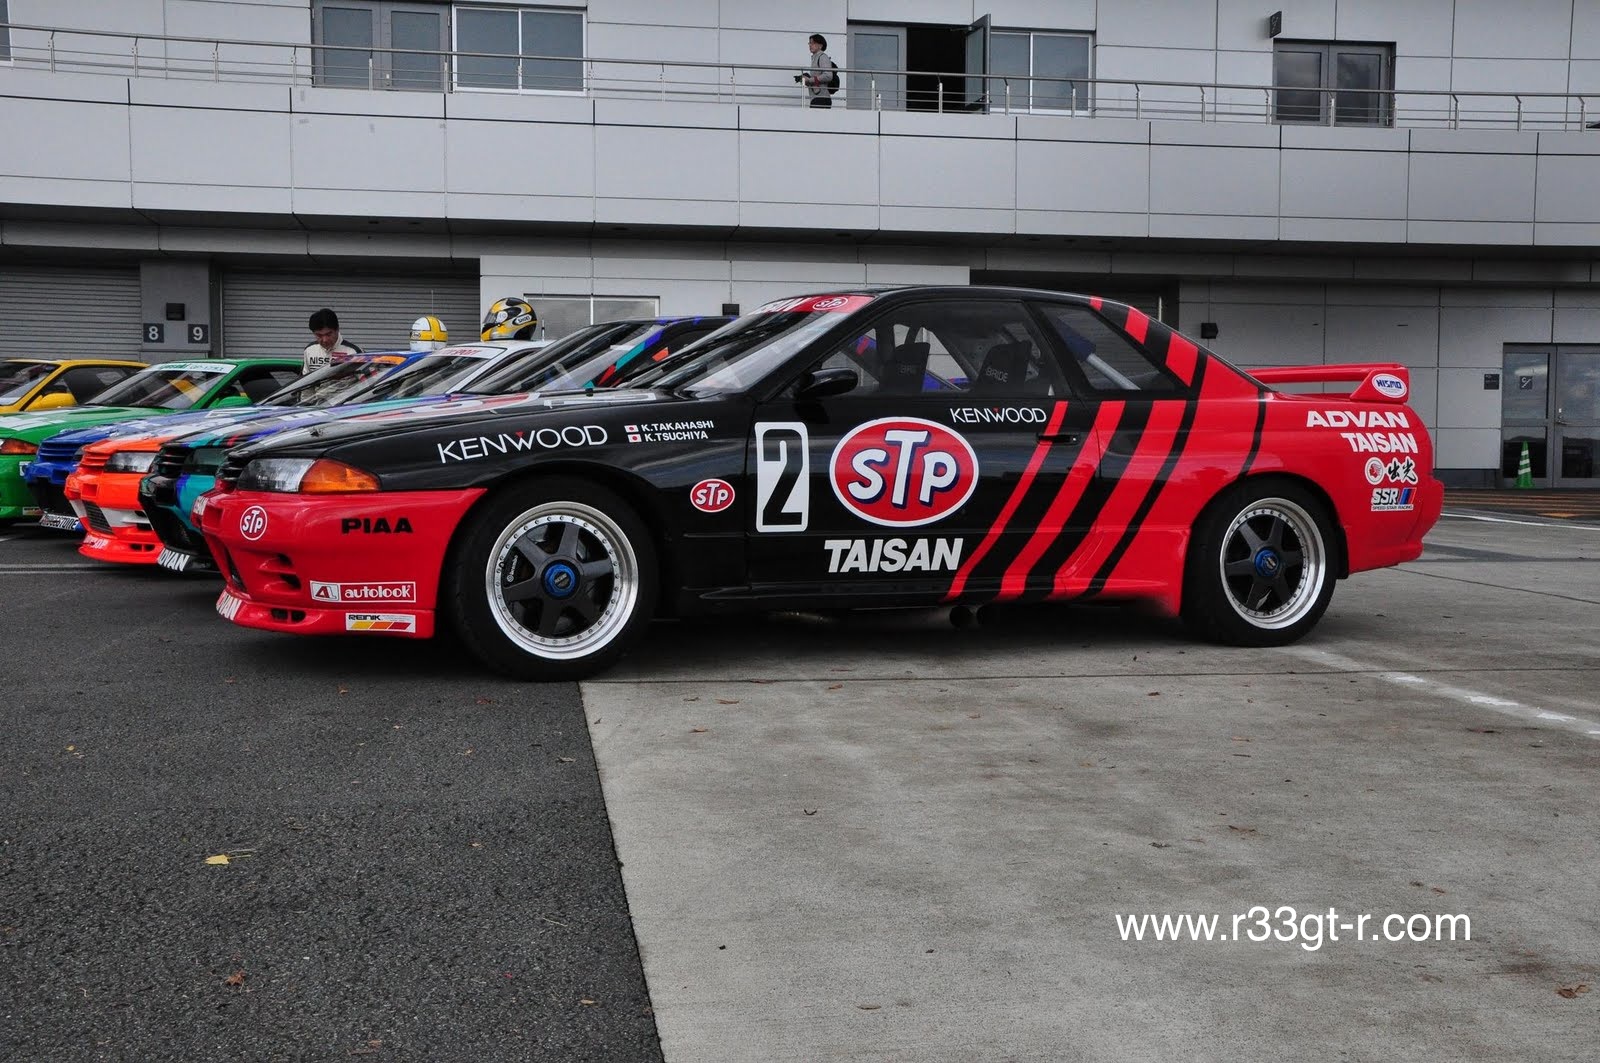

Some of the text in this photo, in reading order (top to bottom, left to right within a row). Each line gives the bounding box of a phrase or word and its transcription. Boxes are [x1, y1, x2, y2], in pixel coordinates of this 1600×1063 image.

[148, 326, 159, 341] 8
[193, 327, 204, 341] 9
[310, 356, 336, 364] NISS
[986, 367, 1008, 382] BRIDE
[1376, 379, 1402, 389] NISMO
[950, 407, 1047, 423] KENWOOD
[1306, 410, 1410, 428] ADVAN
[641, 420, 714, 432] K.TAKAHASHI
[437, 425, 608, 464] KENWOOD
[645, 431, 709, 442] K.TSUCHIYA
[1340, 432, 1418, 454] TAISAN
[847, 429, 957, 506] STP
[1388, 458, 1417, 482] 出光
[761, 428, 804, 526] 2
[694, 482, 729, 507] STP
[1372, 488, 1399, 505] SSR
[242, 509, 264, 534] STP
[341, 518, 413, 534] PIAA
[157, 547, 190, 572] DVAN
[824, 538, 963, 573] TAISAN
[345, 585, 411, 598] autolook
